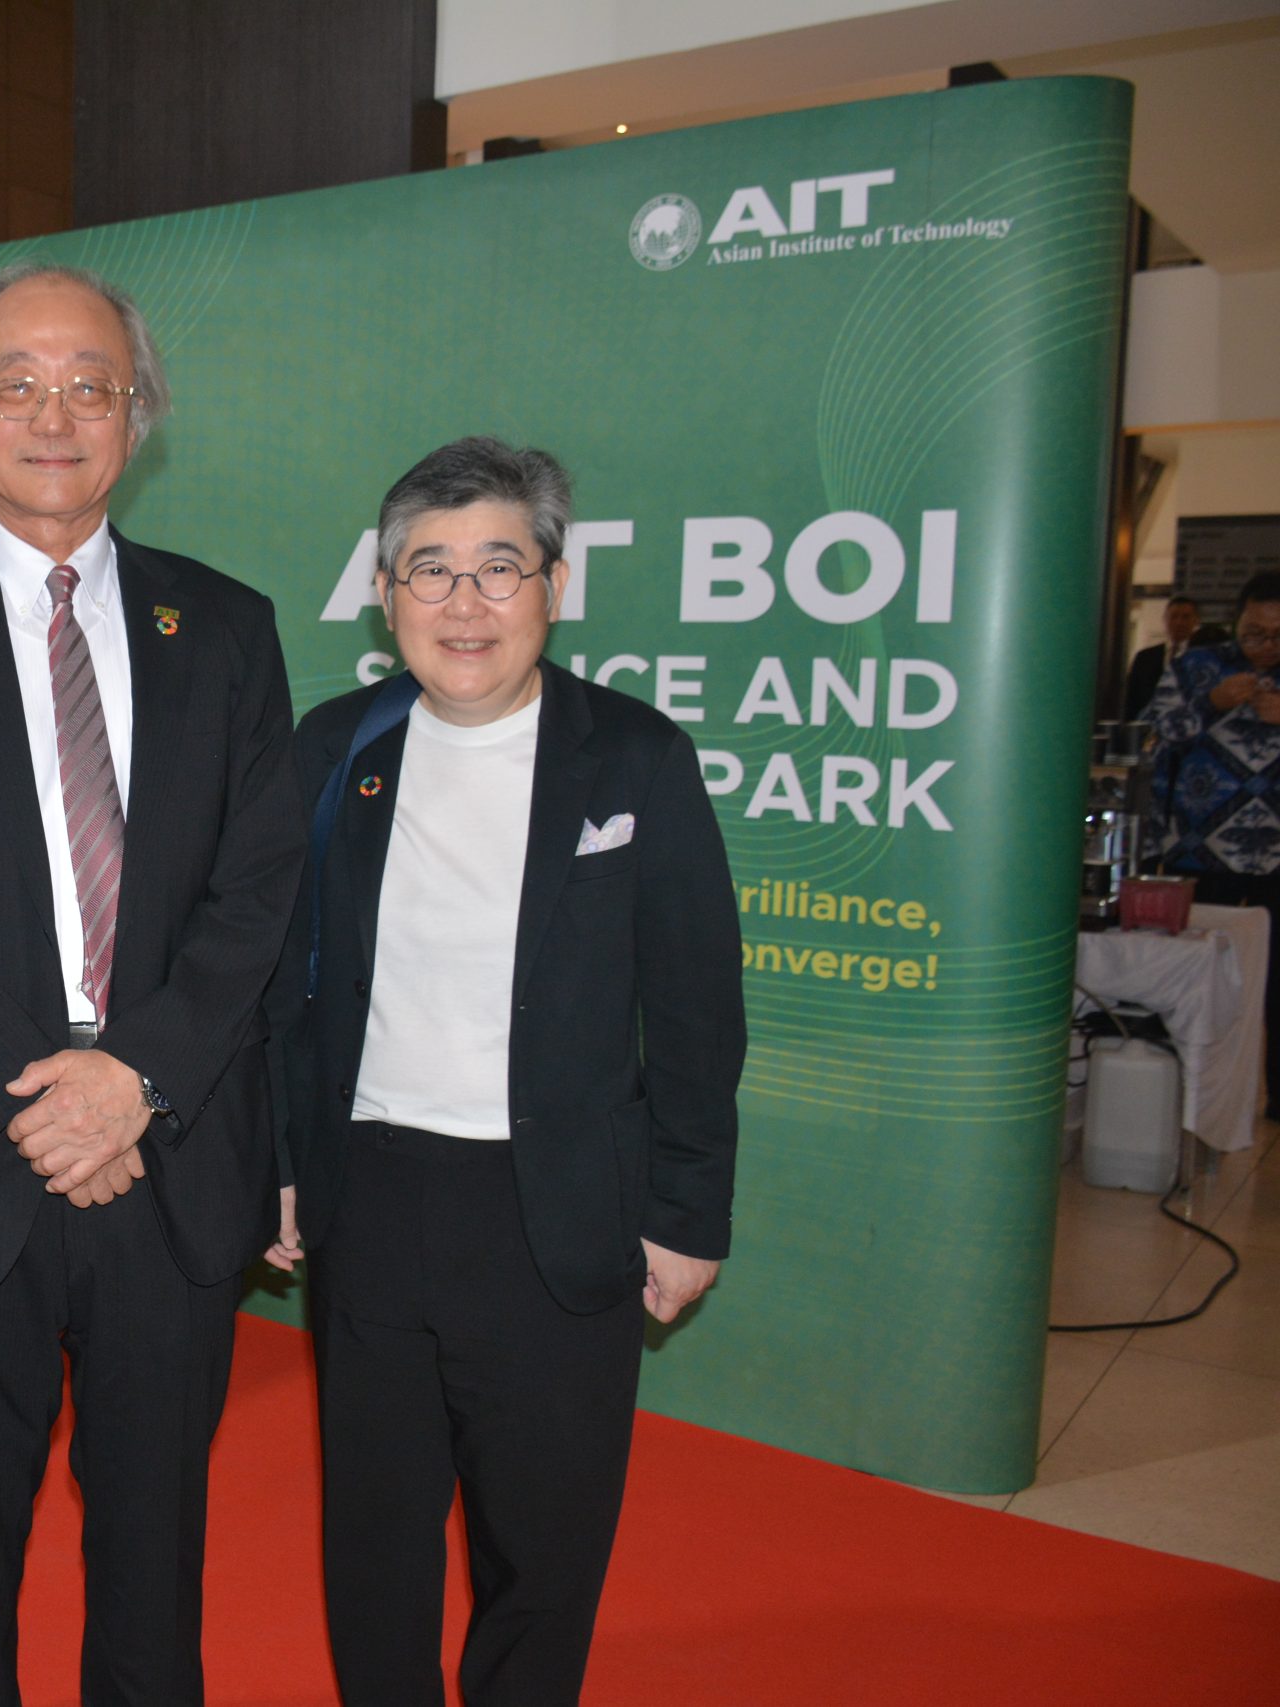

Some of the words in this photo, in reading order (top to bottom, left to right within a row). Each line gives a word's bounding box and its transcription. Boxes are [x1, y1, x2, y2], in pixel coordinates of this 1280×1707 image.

[707, 168, 895, 244] AIT
[707, 243, 763, 266] Asian
[769, 232, 855, 258] Institute
[861, 228, 885, 247] of
[887, 214, 1017, 246] Technology
[319, 519, 635, 622] AT
[679, 510, 957, 624] BOI
[733, 656, 959, 731] AND
[696, 749, 957, 832] PARK
[732, 878, 942, 938] rilliance,
